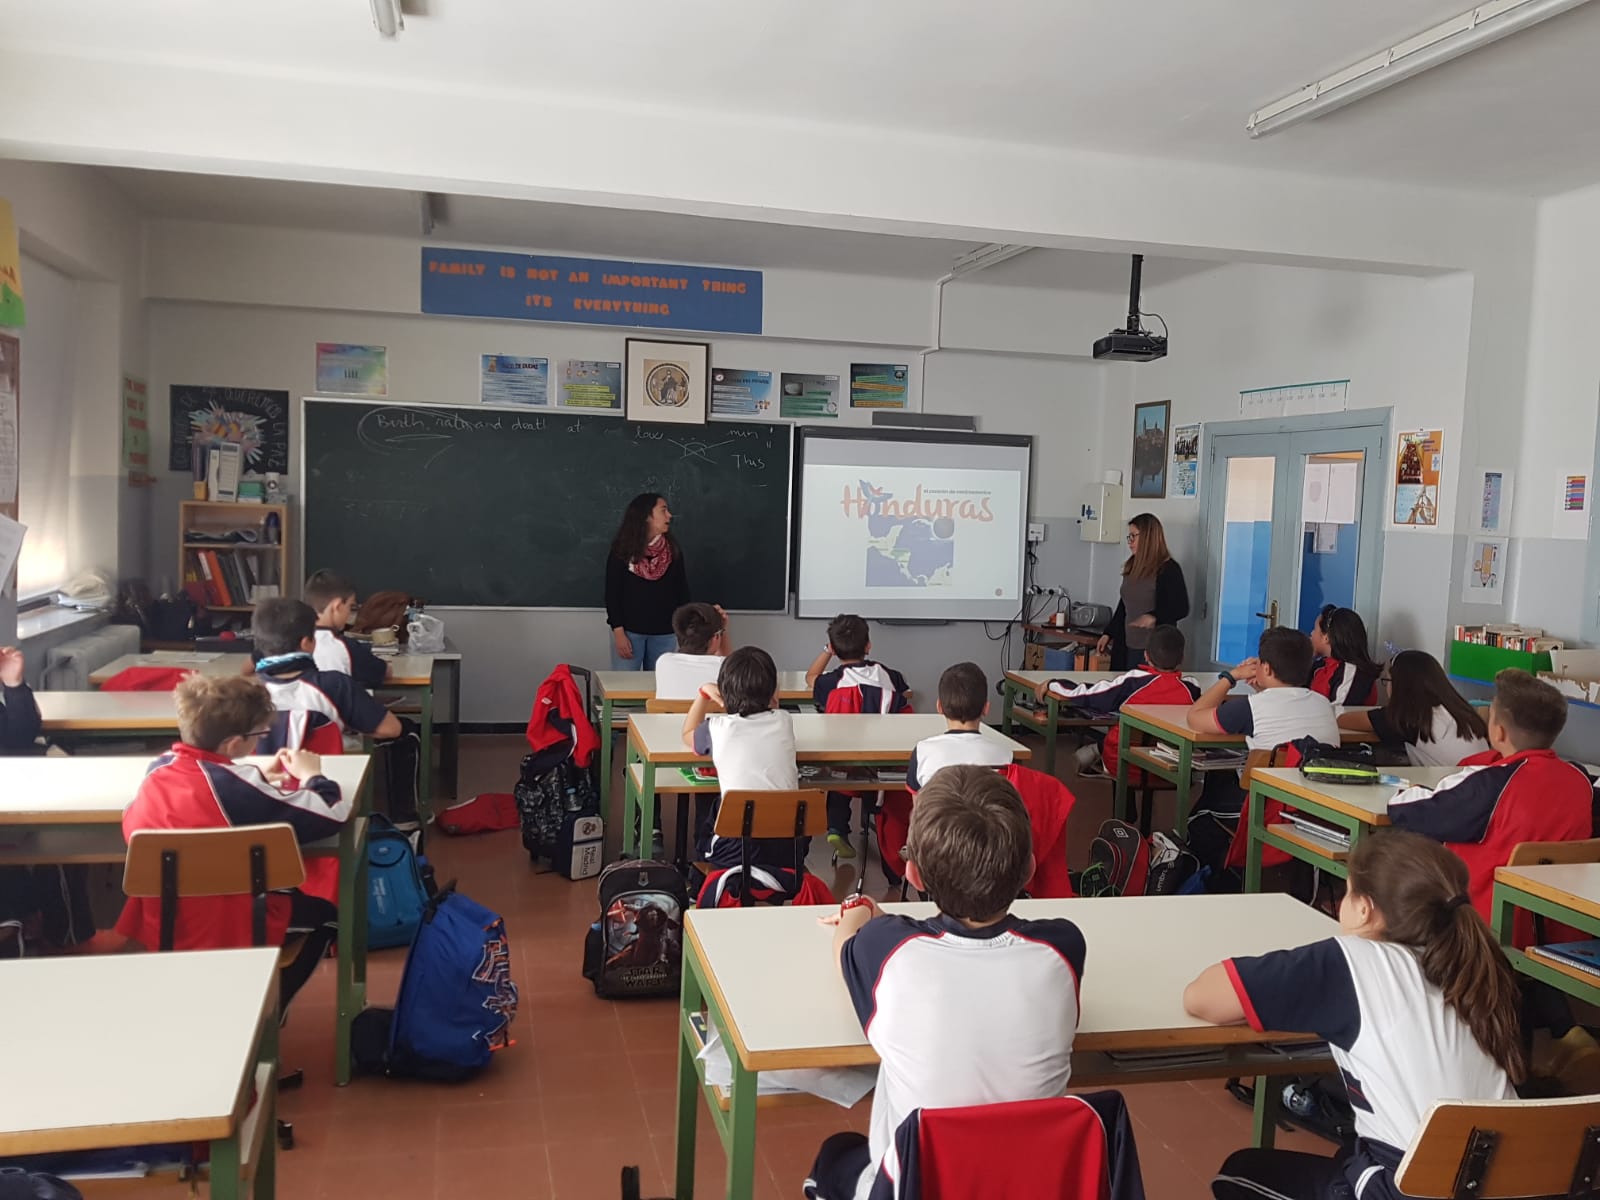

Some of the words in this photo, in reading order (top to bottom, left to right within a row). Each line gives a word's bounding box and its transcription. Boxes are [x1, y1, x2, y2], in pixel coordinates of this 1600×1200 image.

[429, 261, 486, 276] FAMILY
[500, 265, 516, 279] IS
[527, 268, 559, 281] NOT
[568, 271, 590, 283] AN
[602, 275, 688, 290] IMPORTANT
[702, 279, 747, 294] THING
[573, 298, 670, 316] EVERYTHING
[839, 482, 994, 523] Honduras
